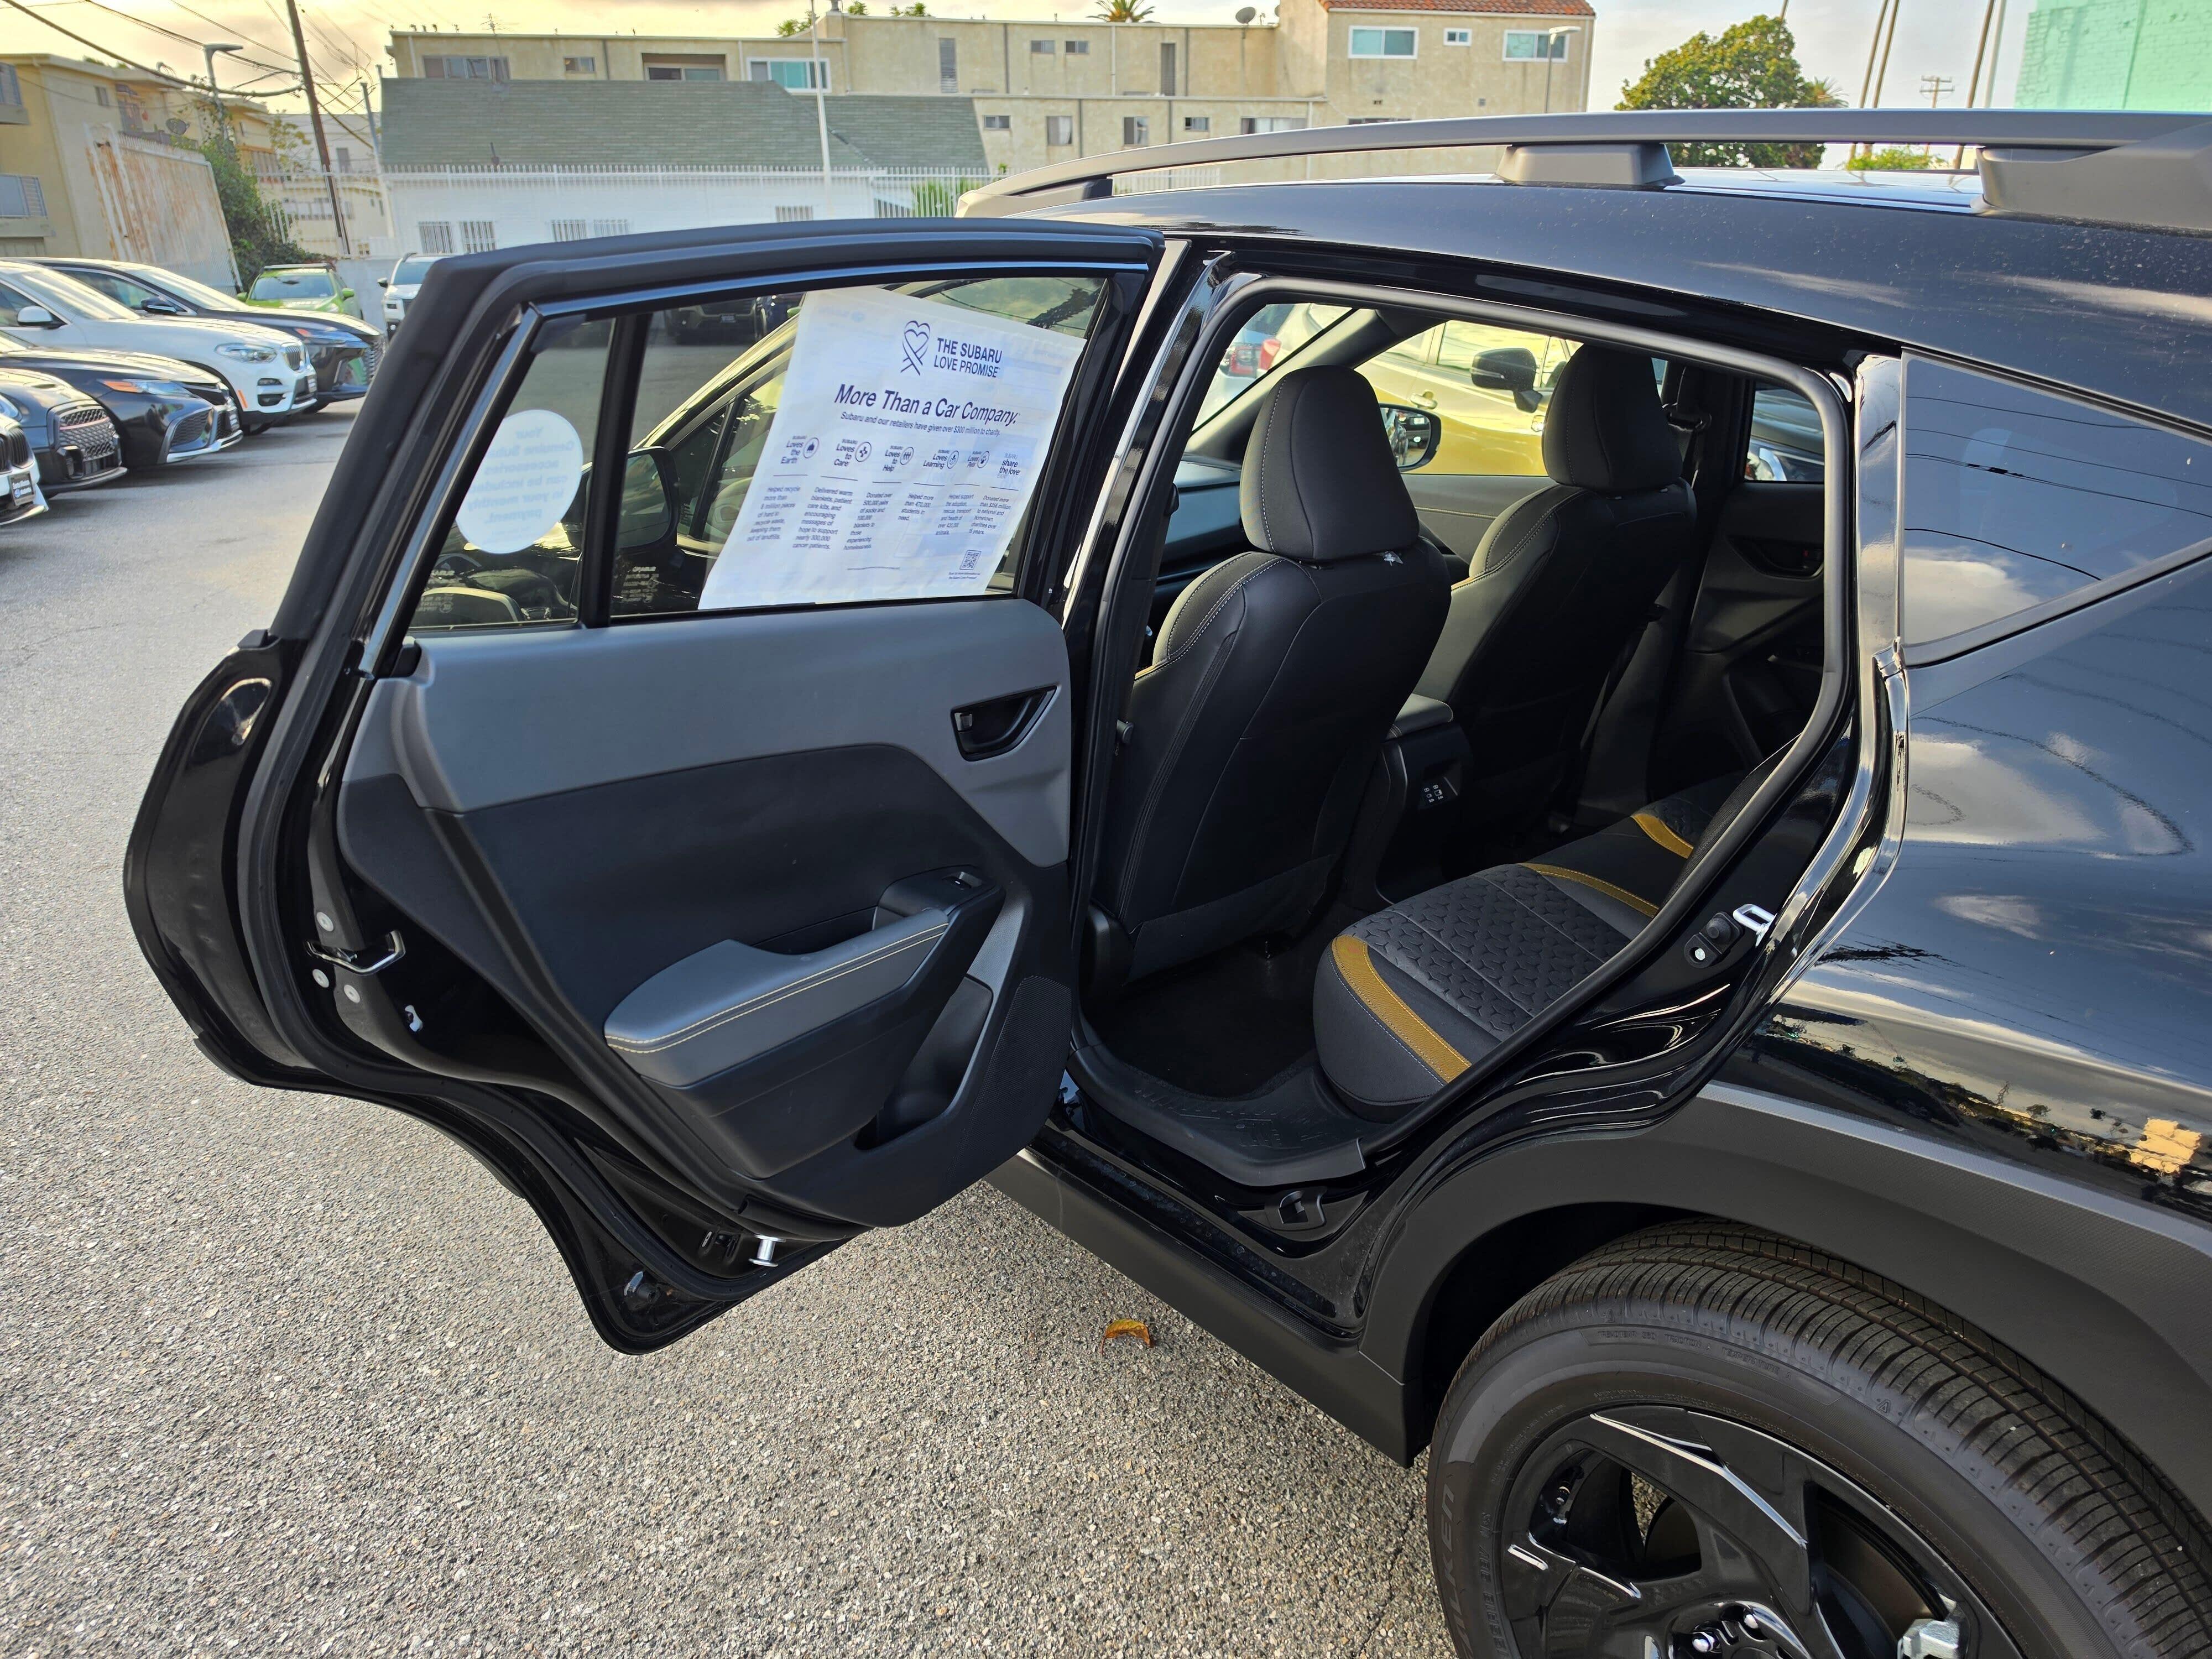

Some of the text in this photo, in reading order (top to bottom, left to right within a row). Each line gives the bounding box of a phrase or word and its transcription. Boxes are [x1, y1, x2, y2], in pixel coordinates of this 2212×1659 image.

[937, 338, 1002, 363] THE SUBARU
[934, 355, 999, 378] LOVE PROMISE
[834, 384, 1018, 426] More Than a Car Company.
[841, 411, 864, 424] Subaru
[865, 416, 877, 424] and
[890, 419, 914, 429] retailers
[914, 421, 927, 430] have
[928, 423, 942, 432] given
[985, 428, 1000, 437] charity.
[836, 444, 855, 452] Loves
[834, 458, 849, 467] Care
[923, 460, 945, 469] Learning
[1001, 459, 1018, 467] share
[1008, 467, 1020, 476] love
[804, 512, 837, 520] encouraging
